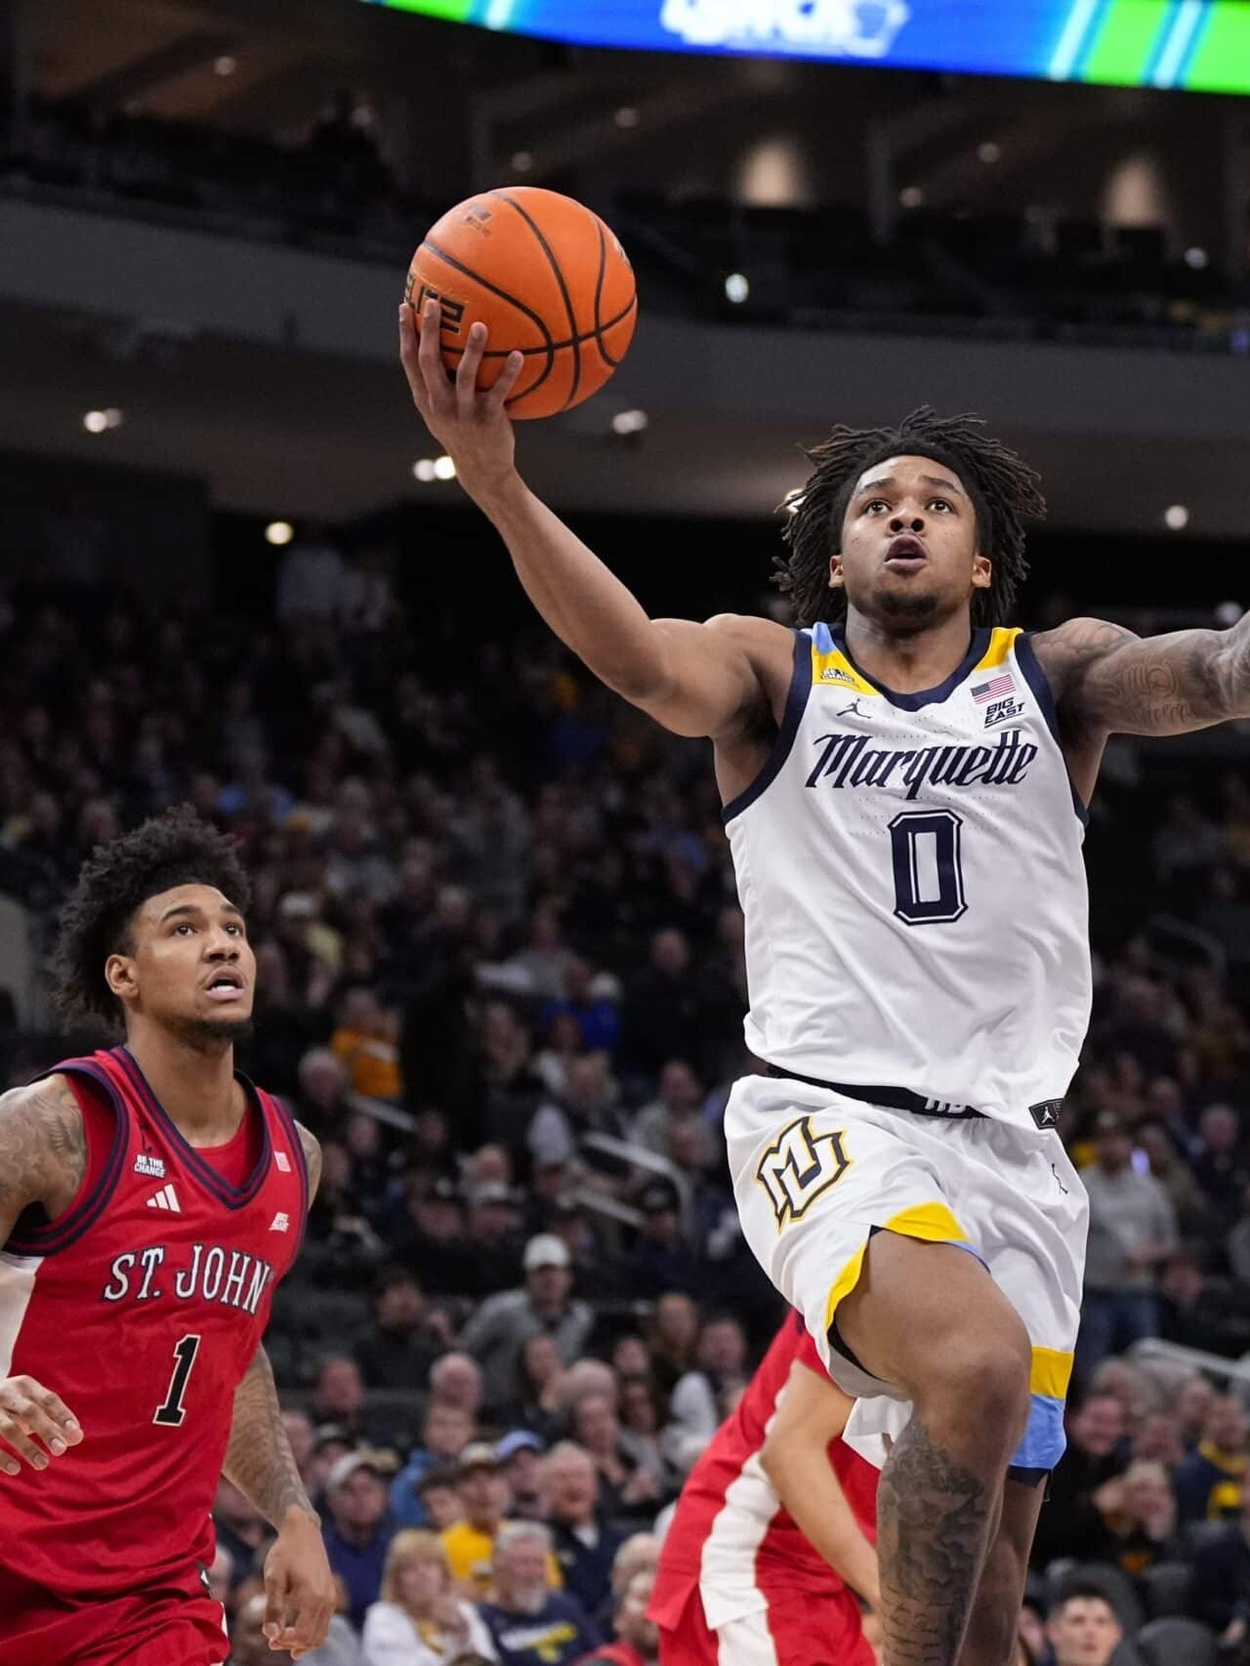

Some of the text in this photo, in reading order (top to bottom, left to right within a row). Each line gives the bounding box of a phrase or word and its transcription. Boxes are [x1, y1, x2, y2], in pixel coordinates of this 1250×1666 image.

[984, 702, 1025, 725] EAST
[986, 697, 1014, 715] BIG
[804, 729, 1039, 800] Marquette
[887, 809, 969, 926] 0
[134, 1163, 165, 1178] CHANGE
[136, 1154, 165, 1168] BE THE
[103, 1245, 167, 1301] ST.
[152, 1333, 202, 1427] 1
